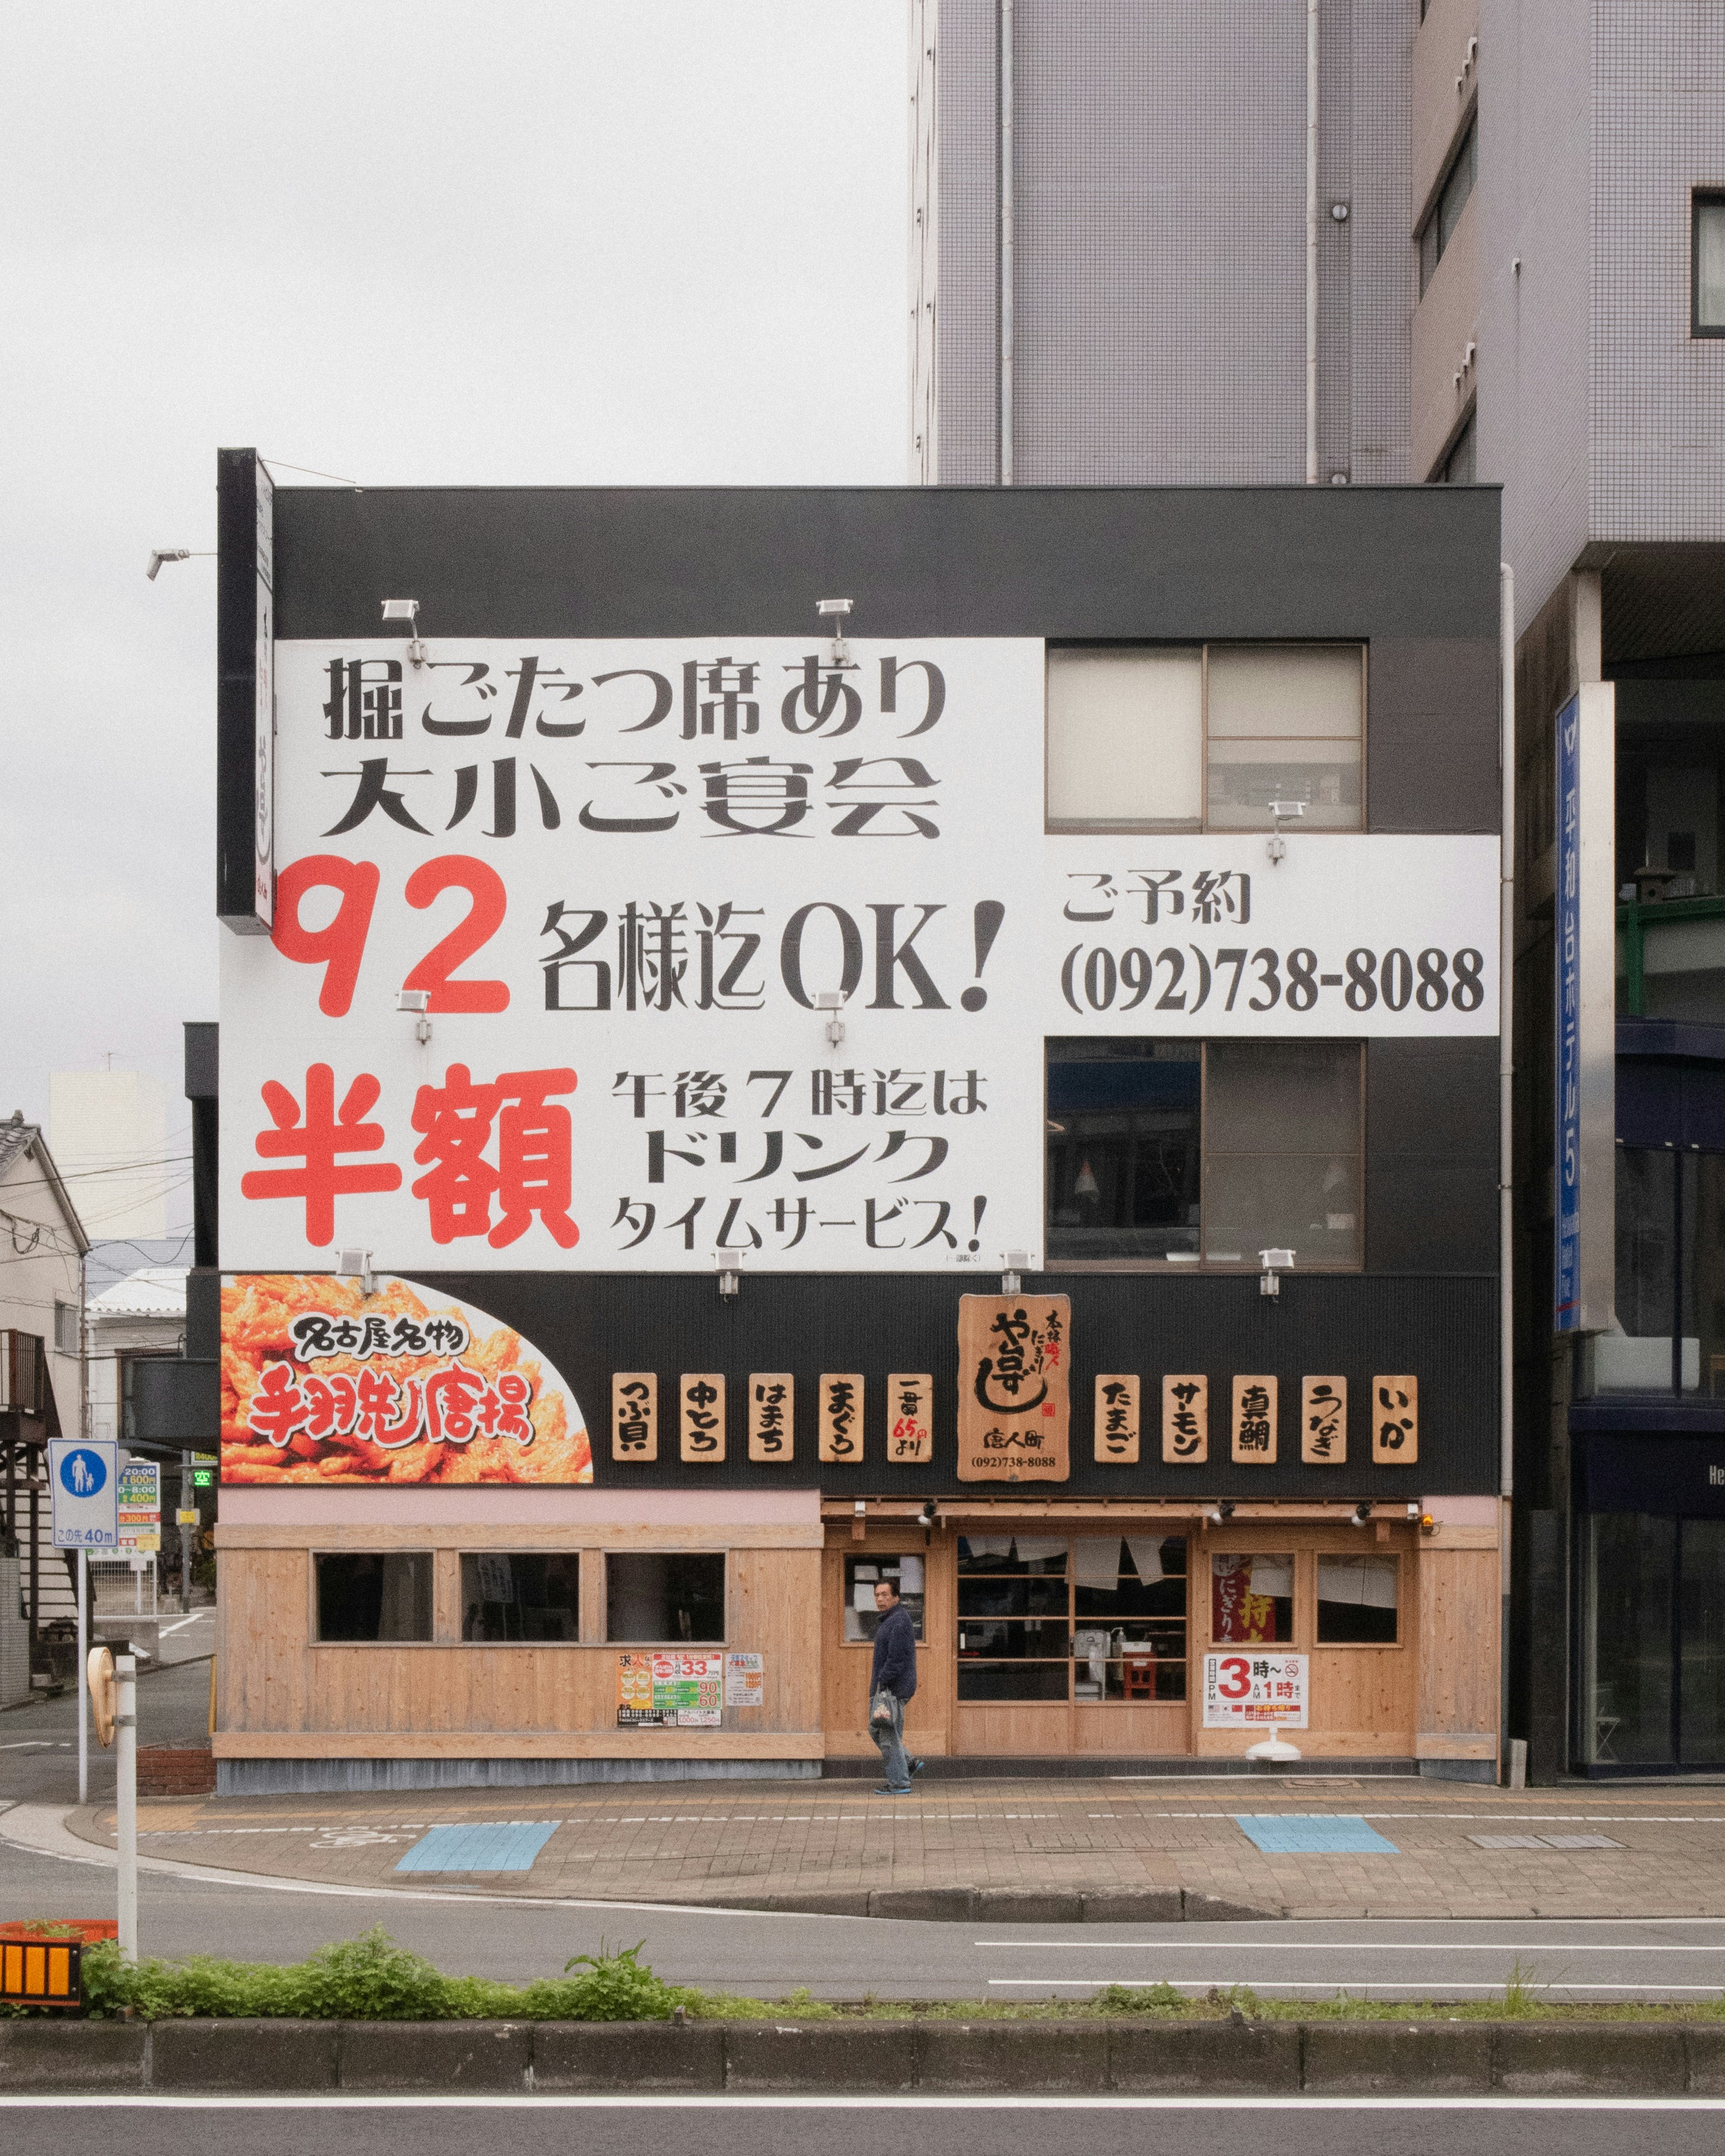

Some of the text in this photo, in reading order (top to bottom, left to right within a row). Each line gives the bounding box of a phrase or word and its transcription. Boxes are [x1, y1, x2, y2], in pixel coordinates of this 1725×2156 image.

[322, 655, 946, 740] 掘ごたつ席あり
[319, 756, 942, 840] 大小ご宴会
[1063, 870, 1251, 925] ご予約
[1061, 943, 1484, 1015] (092)738-8088
[241, 1062, 580, 1249] 半額
[646, 1130, 949, 1183] ドリンク
[611, 1195, 988, 1252] タイムサービス!
[293, 1317, 464, 1353] 名古屋名物
[619, 1382, 651, 1451] つぶ貝
[686, 1381, 719, 1452] 中とろ
[756, 1384, 787, 1452] はまち
[829, 1381, 855, 1454] まぐろ
[984, 1427, 1044, 1450] 唐人町
[1102, 1382, 1136, 1453] たまご
[1171, 1383, 1201, 1455] サーモン
[1239, 1385, 1270, 1451] 真鯛
[1309, 1385, 1343, 1457] うなぎ
[1379, 1386, 1414, 1450] いか
[194, 1471, 210, 1486] 空
[971, 1457, 1056, 1467] (092)738-8088
[58, 1530, 83, 1543] この先
[85, 1529, 113, 1543] 40m
[619, 1654, 644, 1667] 求人
